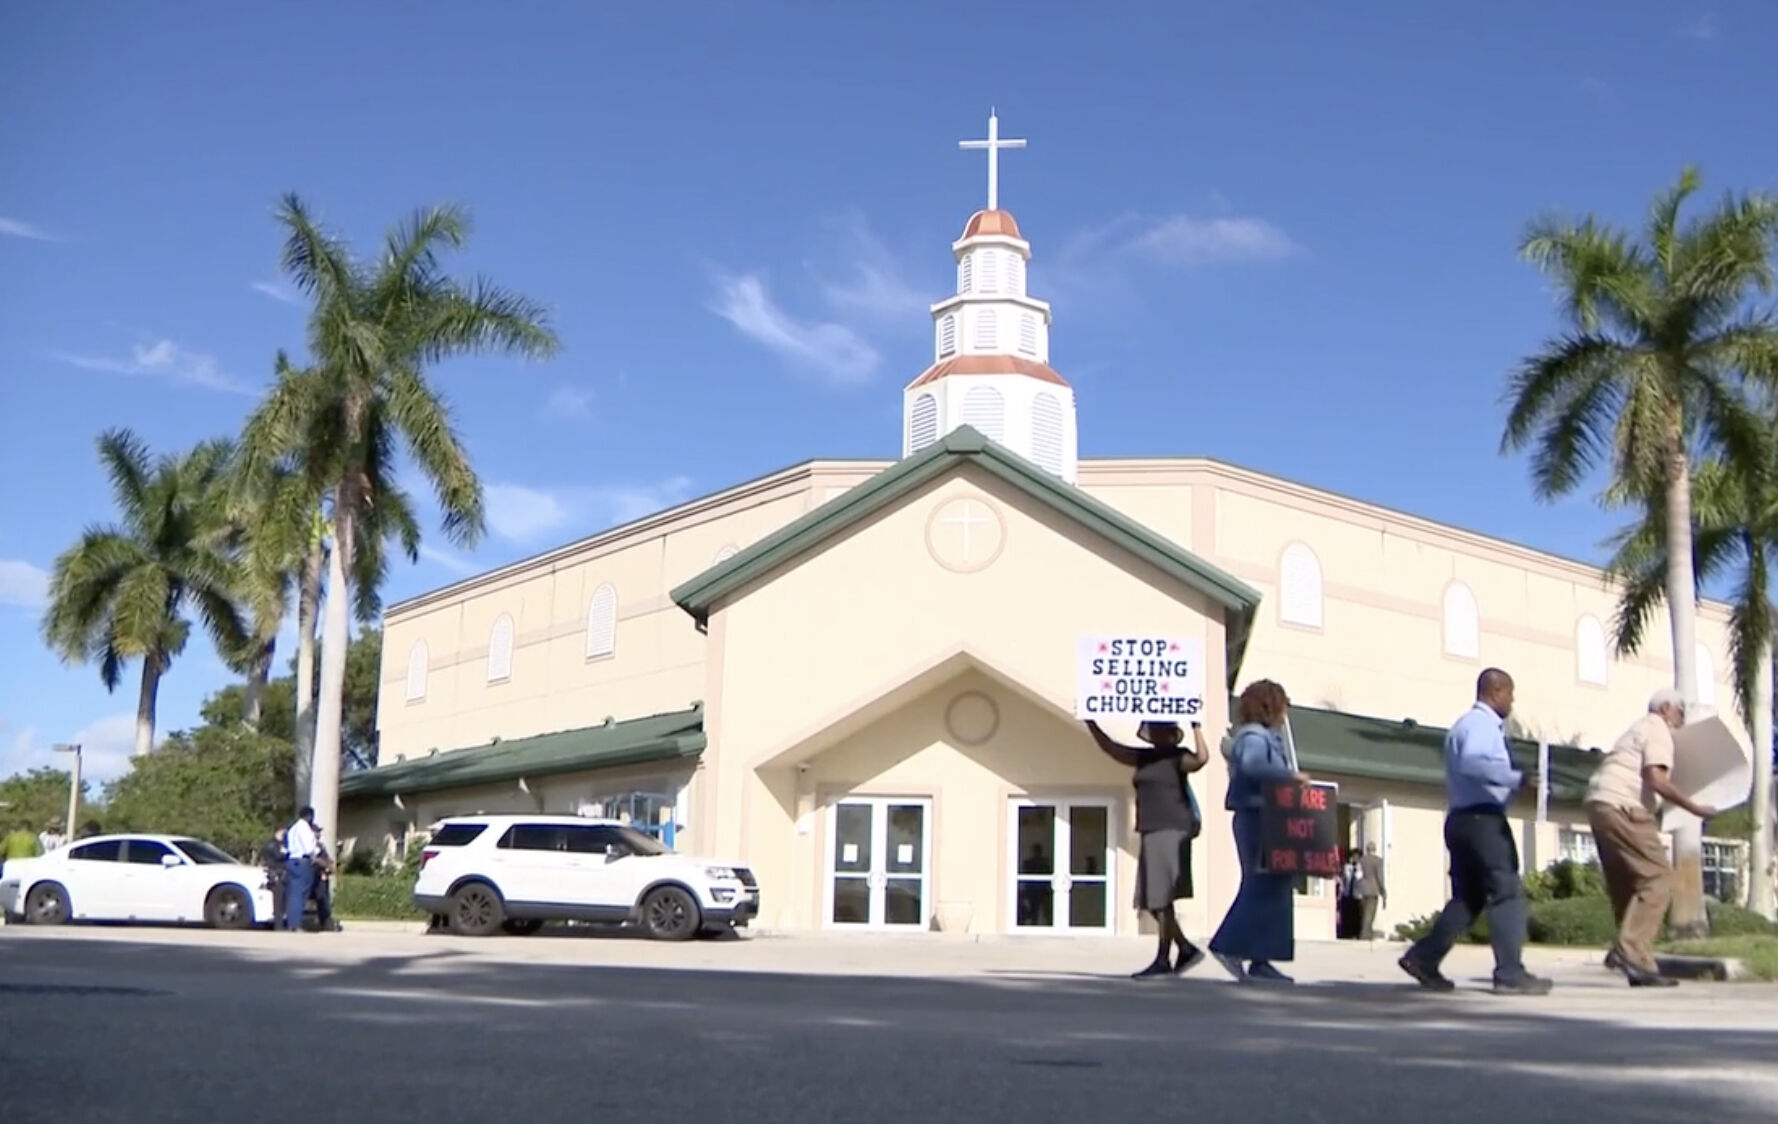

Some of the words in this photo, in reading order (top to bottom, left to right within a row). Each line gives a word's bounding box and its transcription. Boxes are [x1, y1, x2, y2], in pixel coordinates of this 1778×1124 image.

[1111, 638, 1167, 657] STOP
[1092, 658, 1188, 678] SELLING
[1115, 678, 1158, 695] OUR
[1086, 695, 1199, 715] CHURCHES
[1299, 788, 1328, 810] ARE
[1286, 818, 1315, 838] NOT
[1271, 849, 1298, 871] FOR
